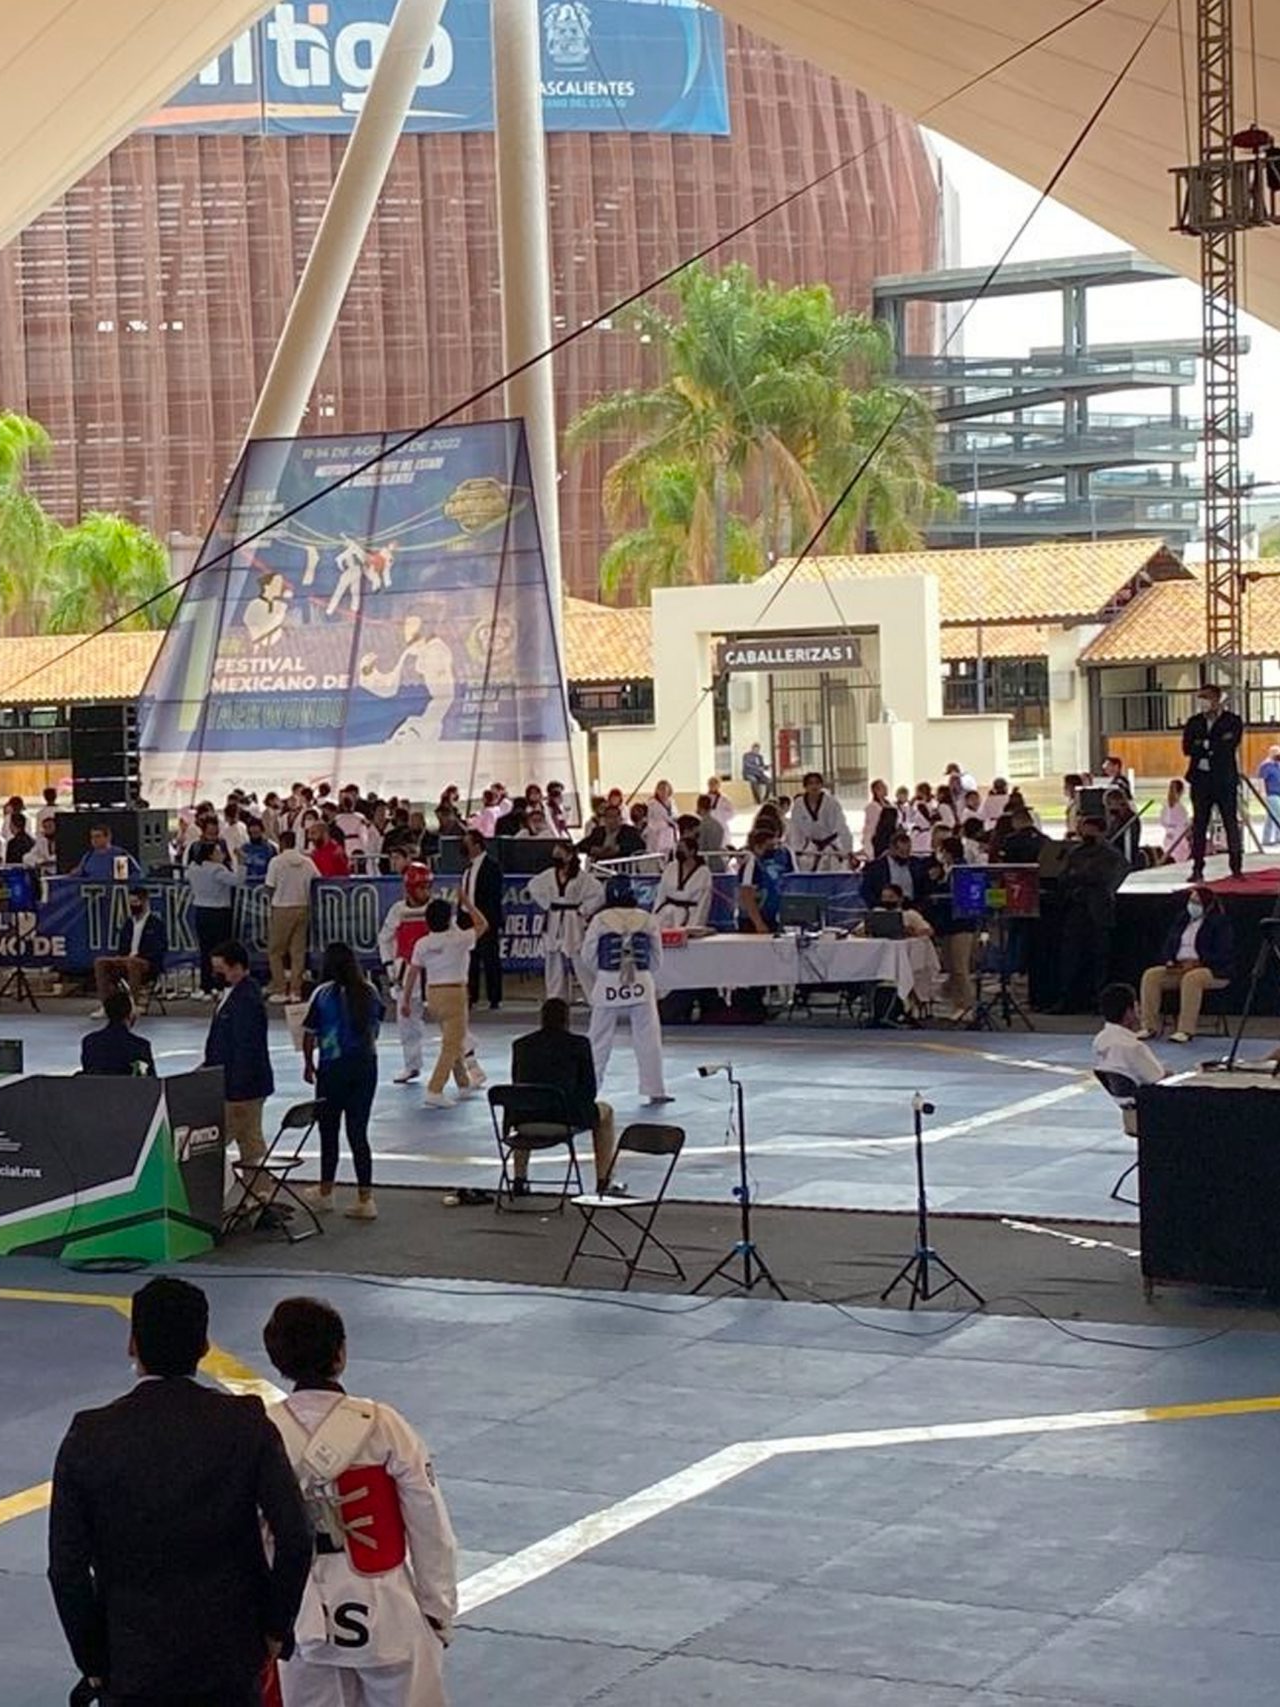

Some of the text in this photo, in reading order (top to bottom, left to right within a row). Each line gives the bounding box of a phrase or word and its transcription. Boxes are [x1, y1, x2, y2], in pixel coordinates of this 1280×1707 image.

[214, 656, 306, 674] FESTIVAL
[725, 646, 853, 665] CABALLERIZAS 1
[210, 673, 350, 694] MEXICANO DE
[33, 936, 66, 956] DE
